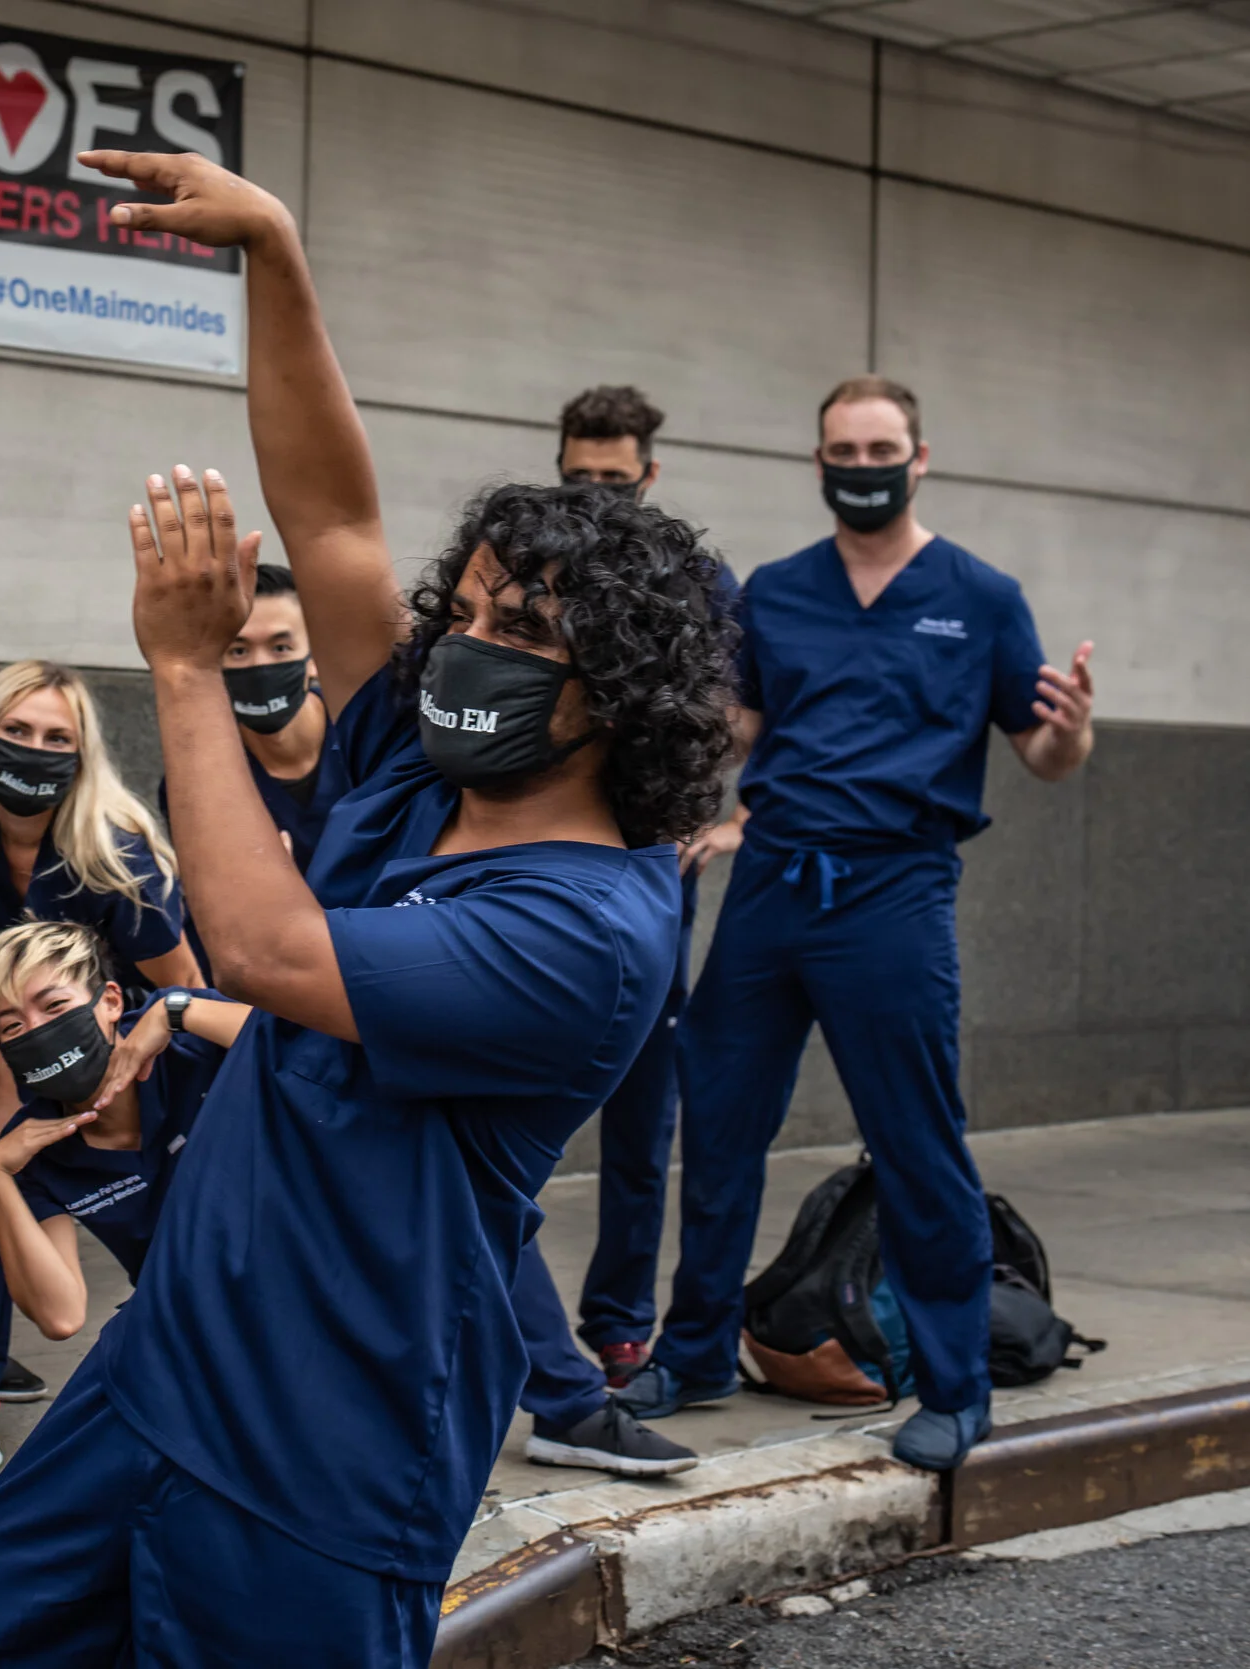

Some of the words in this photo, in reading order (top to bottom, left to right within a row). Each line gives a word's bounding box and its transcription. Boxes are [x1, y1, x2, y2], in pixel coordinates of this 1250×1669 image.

[459, 707, 500, 734] EM
[22, 1062, 64, 1084] Maimo
[58, 1046, 86, 1069] EM
